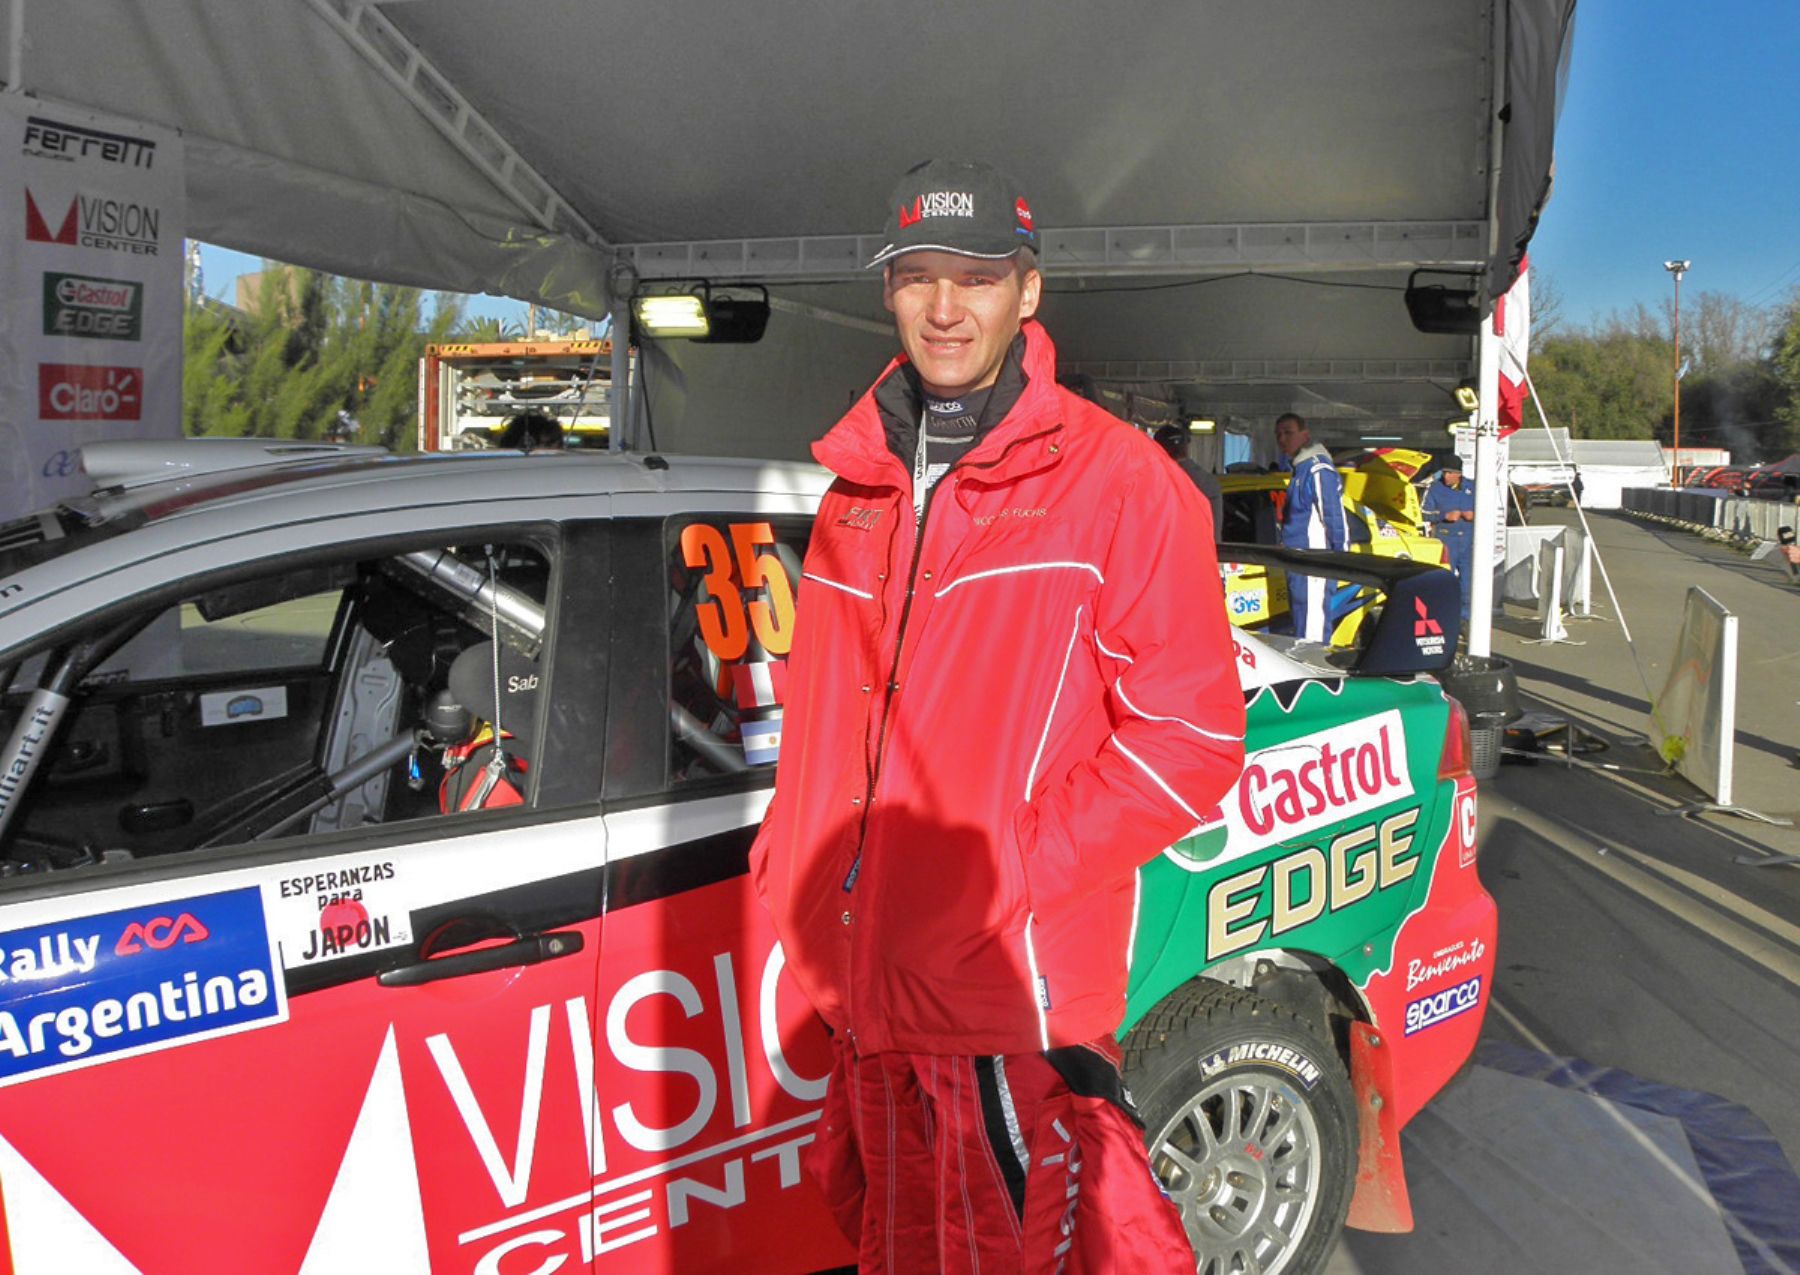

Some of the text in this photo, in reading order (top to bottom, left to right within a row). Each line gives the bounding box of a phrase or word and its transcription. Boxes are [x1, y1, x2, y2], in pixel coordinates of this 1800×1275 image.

[80, 195, 159, 241] VISION
[921, 192, 974, 210] VISION
[921, 208, 975, 218] CENTER
[81, 236, 159, 256] CENTER
[76, 284, 130, 307] Castrol
[54, 308, 134, 334] EDGE
[50, 382, 120, 413] Claro
[681, 523, 796, 660] 35
[508, 674, 540, 693] Sab
[1238, 724, 1401, 837] Castrol
[280, 862, 395, 898] ESPERANZAS
[317, 888, 364, 911] para
[1205, 804, 1424, 964] EDGE
[302, 915, 391, 960] JAPON
[1405, 937, 1485, 992] Benvenuto
[1406, 979, 1480, 1030] sparco
[425, 939, 834, 1209] VISIO
[1227, 1042, 1320, 1082] MICHELIN
[474, 1132, 817, 1275] CENT
